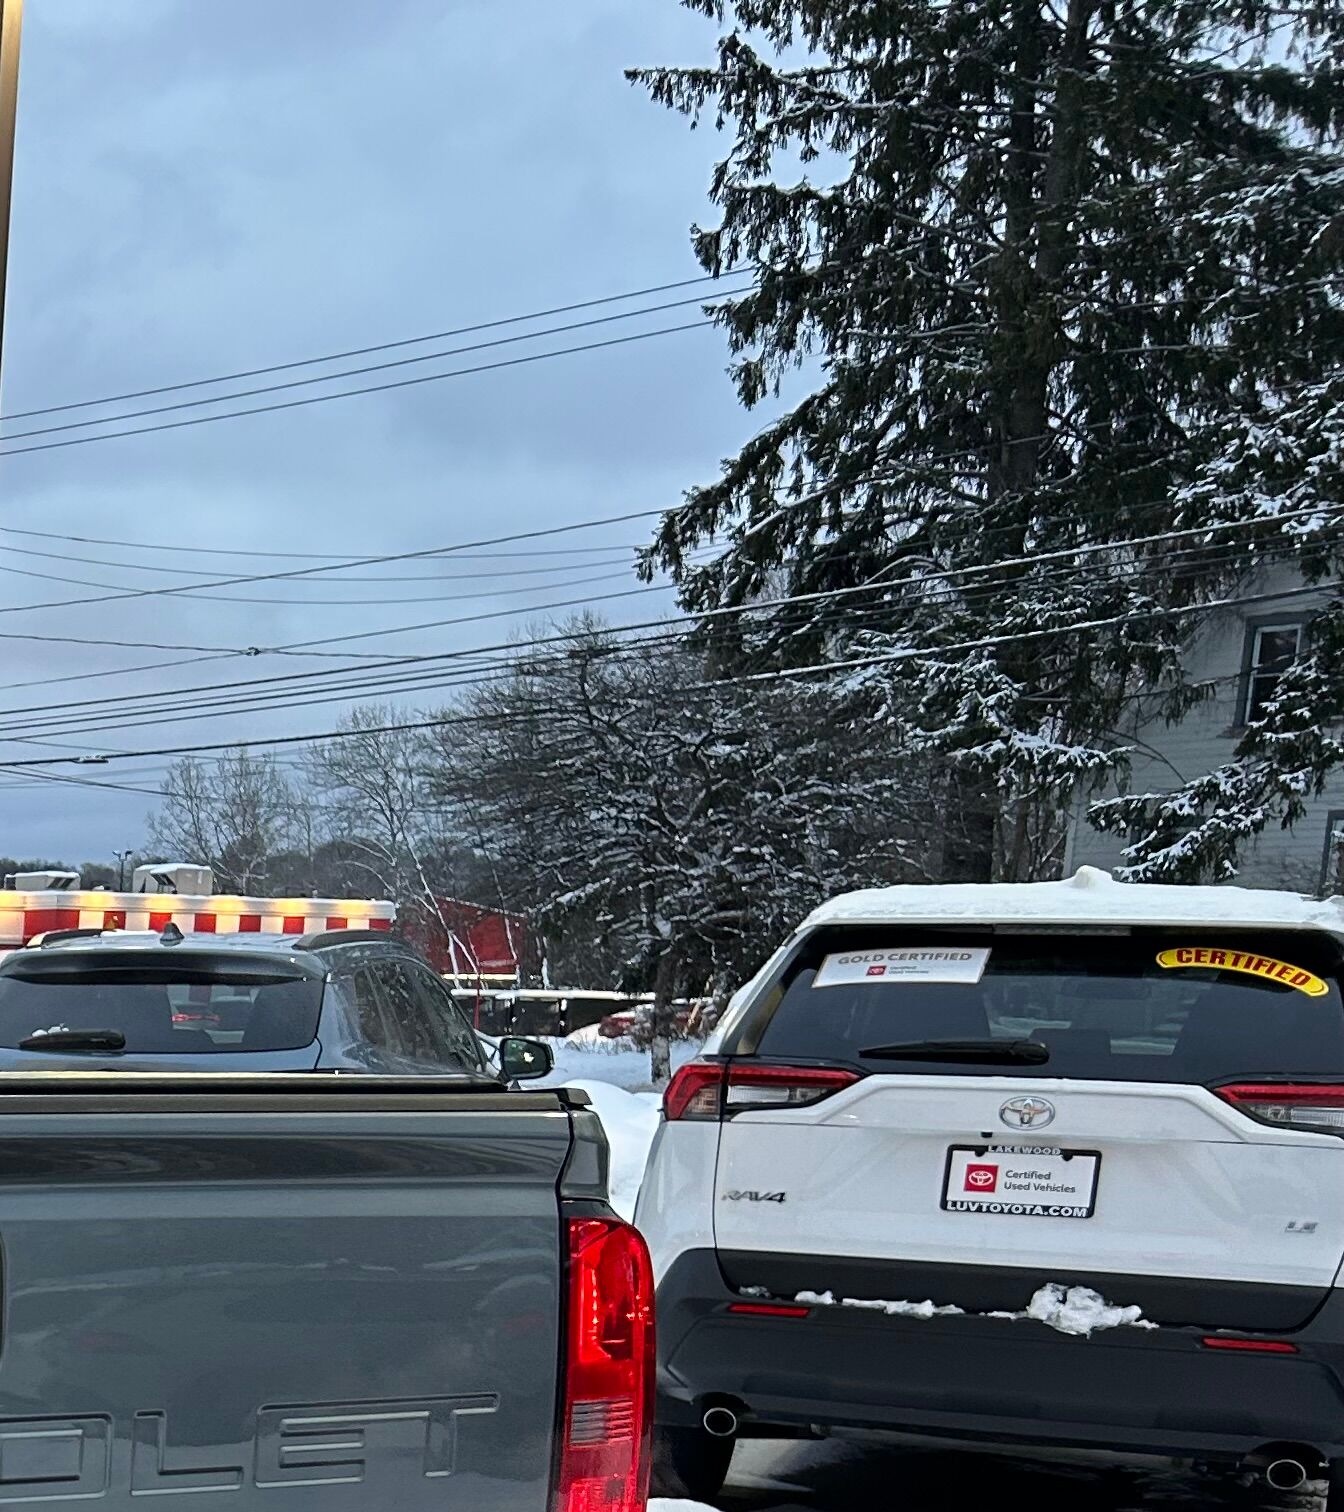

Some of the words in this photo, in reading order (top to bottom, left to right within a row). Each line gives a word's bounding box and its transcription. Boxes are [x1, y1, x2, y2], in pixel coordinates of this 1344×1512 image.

[837, 954, 884, 964] GOLD
[887, 952, 973, 962] CERTIFIED
[1176, 949, 1312, 987] CERTIFIED
[987, 1145, 1062, 1156] LAKEWOOD
[1006, 1170, 1052, 1180] Certified
[1004, 1182, 1030, 1191] Used
[1033, 1183, 1076, 1193] Vehicles
[721, 1190, 786, 1203] RAV4
[946, 1200, 1087, 1218] LUVTOYOTA.COM
